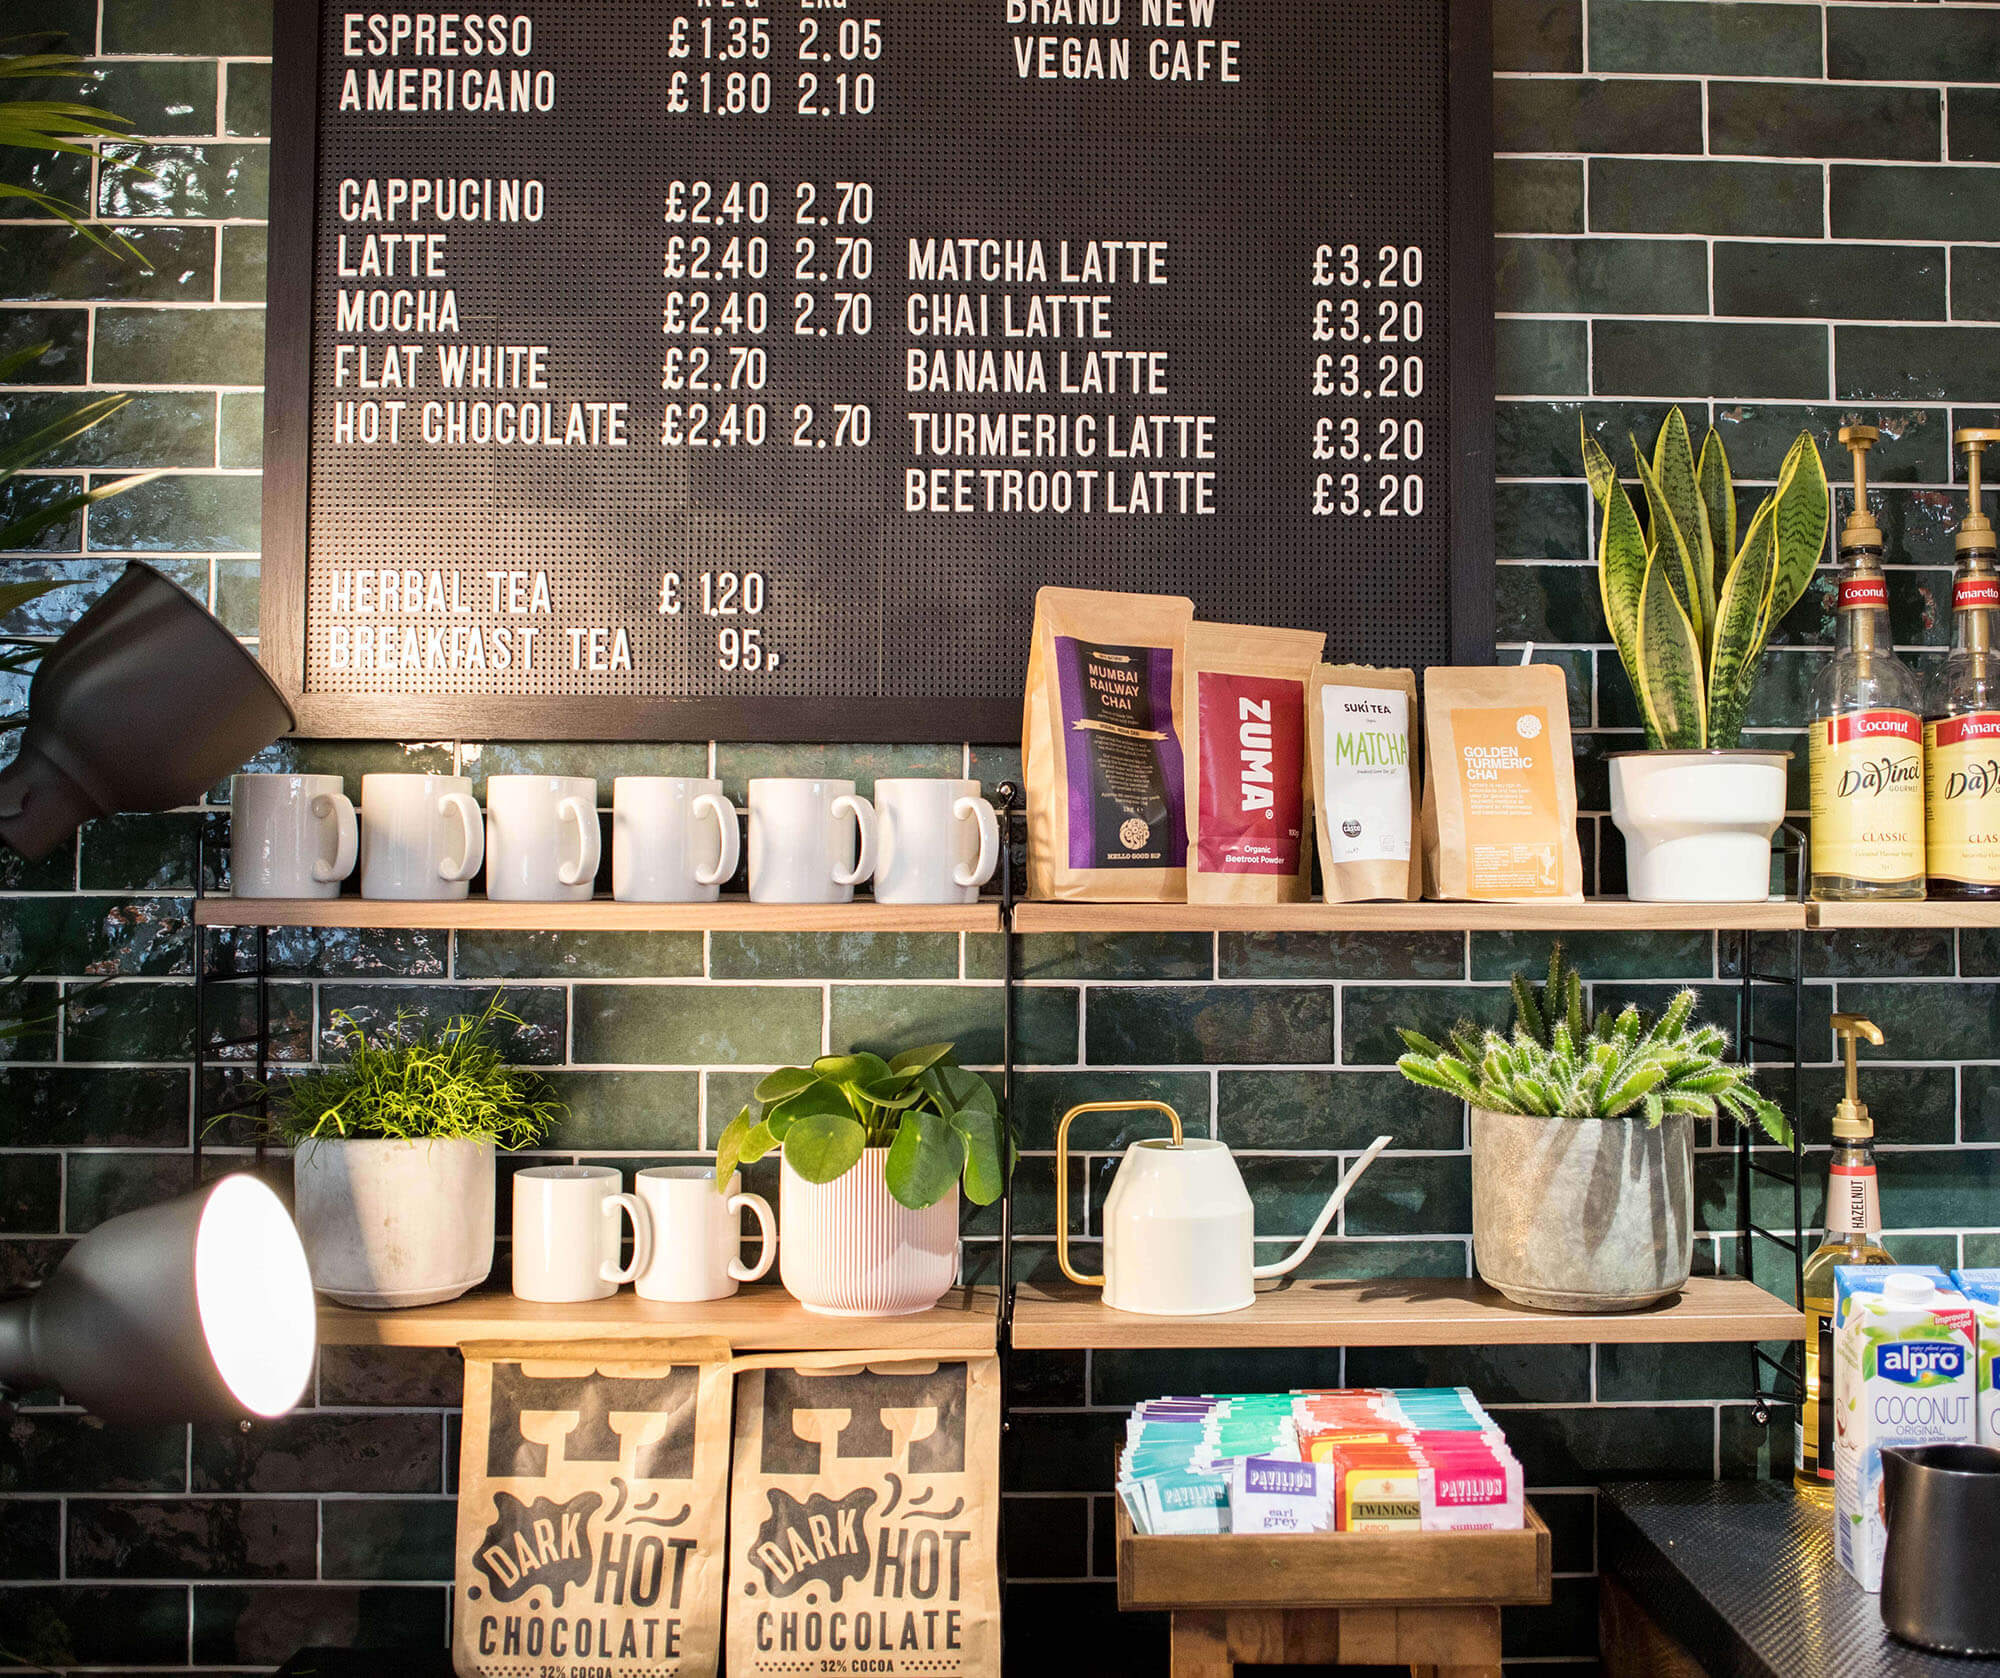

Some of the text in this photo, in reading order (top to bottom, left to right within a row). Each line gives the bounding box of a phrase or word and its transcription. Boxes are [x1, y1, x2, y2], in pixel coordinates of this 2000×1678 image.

[1006, 0, 1215, 28] BRAND NEW
[343, 13, 533, 57] ESPRESSO
[799, 17, 882, 62] 2.05
[1013, 36, 1241, 82] VEGAN CAFE
[339, 68, 555, 112] AMERICANO
[798, 72, 875, 116] 2.10
[339, 178, 873, 226] CAPPUCINO £2.40 2.70
[337, 234, 873, 281] LATTE £2.40 2.70
[908, 238, 1423, 288] MATCHA LATTE £3.20
[336, 289, 872, 336] MOCHA £2.40 2.70
[907, 293, 1424, 344] CHAI LATTE £3.20
[335, 345, 767, 392] FLAT WHITE £2.70
[906, 349, 1424, 399] BANANA LATTE £3.20
[334, 400, 871, 449] HOT CHOCOLATE £2.40 2.70
[908, 412, 1424, 462] TURMERIC LATTE £3.20
[905, 468, 1424, 518] BEETROOT LATTE £3.20
[330, 569, 472, 615] HERBAL
[486, 570, 553, 615] TEA
[1844, 588, 1884, 599] Coconut
[1956, 588, 1999, 601] Amaretto
[329, 627, 540, 671] BREAKFAST
[566, 627, 632, 672] TEA
[1088, 663, 1138, 683] MUMBAI
[1089, 677, 1140, 697] RAILWAY
[1101, 694, 1132, 710] CHAI
[1370, 704, 1392, 714] TEA
[1857, 719, 1909, 733] Coconut
[1336, 731, 1408, 767] MATCHA
[1463, 746, 1519, 758] GOLDEN
[1464, 756, 1533, 769] TURMERIC
[1466, 768, 1498, 780] CHAI
[1861, 832, 1909, 842] CLASSIC
[1225, 854, 1285, 865] Beetroot Powder
[1243, 844, 1272, 855] Organic
[1851, 1180, 1864, 1229] HAZELNUT
[1934, 1312, 1971, 1326] Improved
[1949, 1319, 1972, 1330] recipe
[1884, 1345, 1959, 1377] alpro
[1875, 1396, 1971, 1425] COCONUT
[1895, 1425, 1945, 1436] ORIGINAL
[1250, 1470, 1313, 1489] PAVILION
[1440, 1479, 1503, 1498] PAVILION
[1164, 1484, 1225, 1505] PAVILION
[1268, 1508, 1294, 1518] earl
[1358, 1503, 1420, 1517] TWININGS
[1263, 1517, 1298, 1529] grey
[1359, 1522, 1390, 1532] Lemon
[1450, 1522, 1495, 1531] summer
[482, 1512, 698, 1610] DARK HOT
[757, 1507, 971, 1602] DARK HOT
[479, 1615, 681, 1658] CHOCOLATE
[756, 1611, 961, 1652] CHOCOLATE
[540, 1665, 613, 1678] 32% COCOA
[820, 1659, 894, 1673] 32% COCOA
